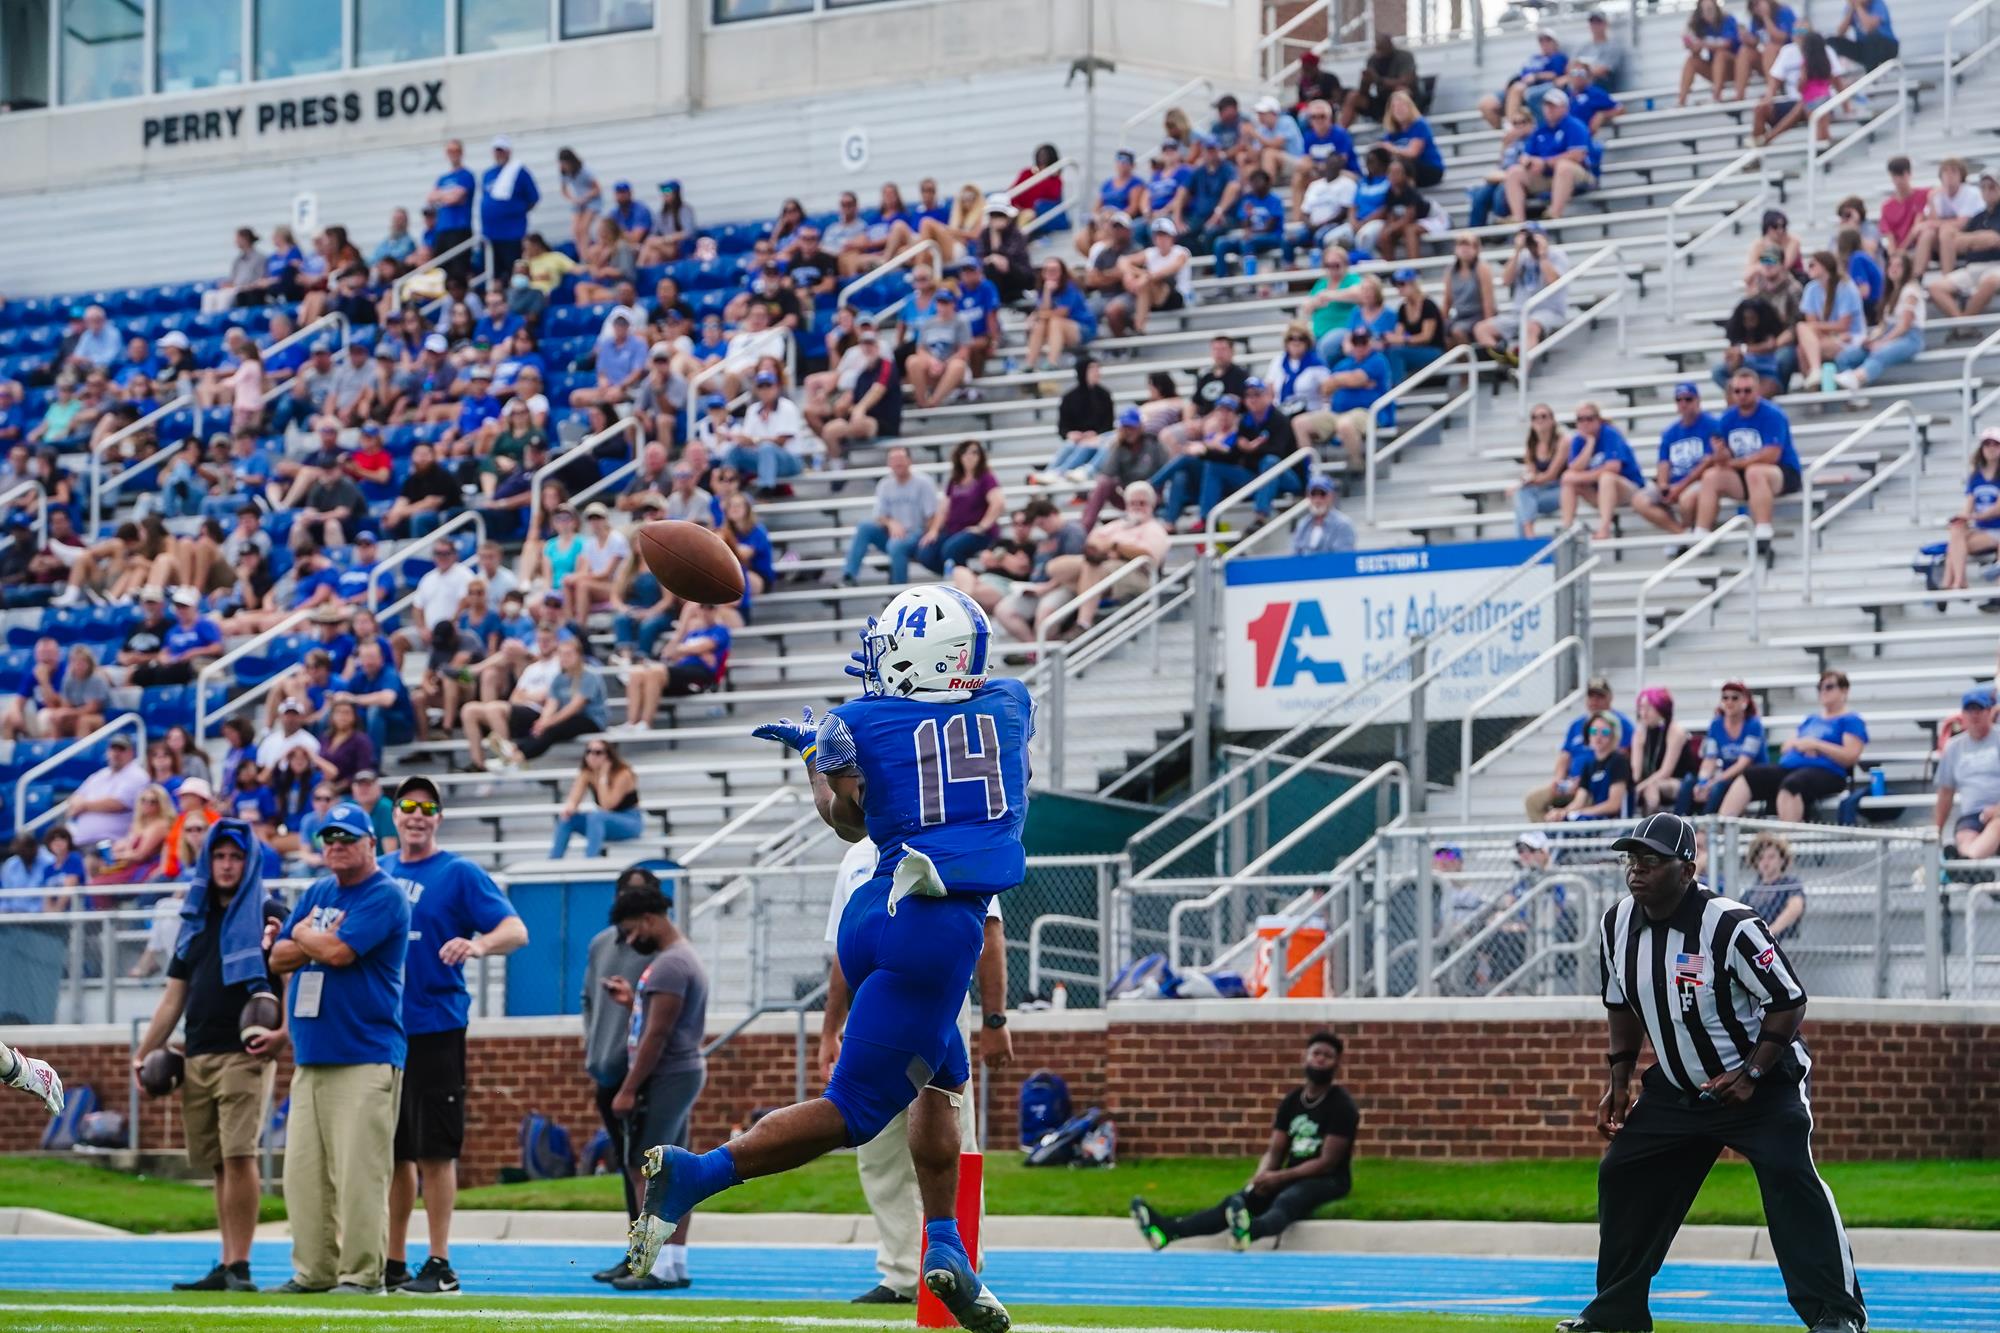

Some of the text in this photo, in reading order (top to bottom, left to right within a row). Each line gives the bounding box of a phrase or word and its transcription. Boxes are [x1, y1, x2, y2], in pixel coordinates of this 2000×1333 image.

[143, 79, 445, 148] PERRY PRESS BOX
[846, 134, 864, 162] G
[1356, 552, 1418, 573] SECTION
[895, 605, 928, 637] 14
[1361, 590, 1540, 641] 1st Advantage
[913, 713, 1008, 827] 14
[1680, 993, 1694, 1012] F
